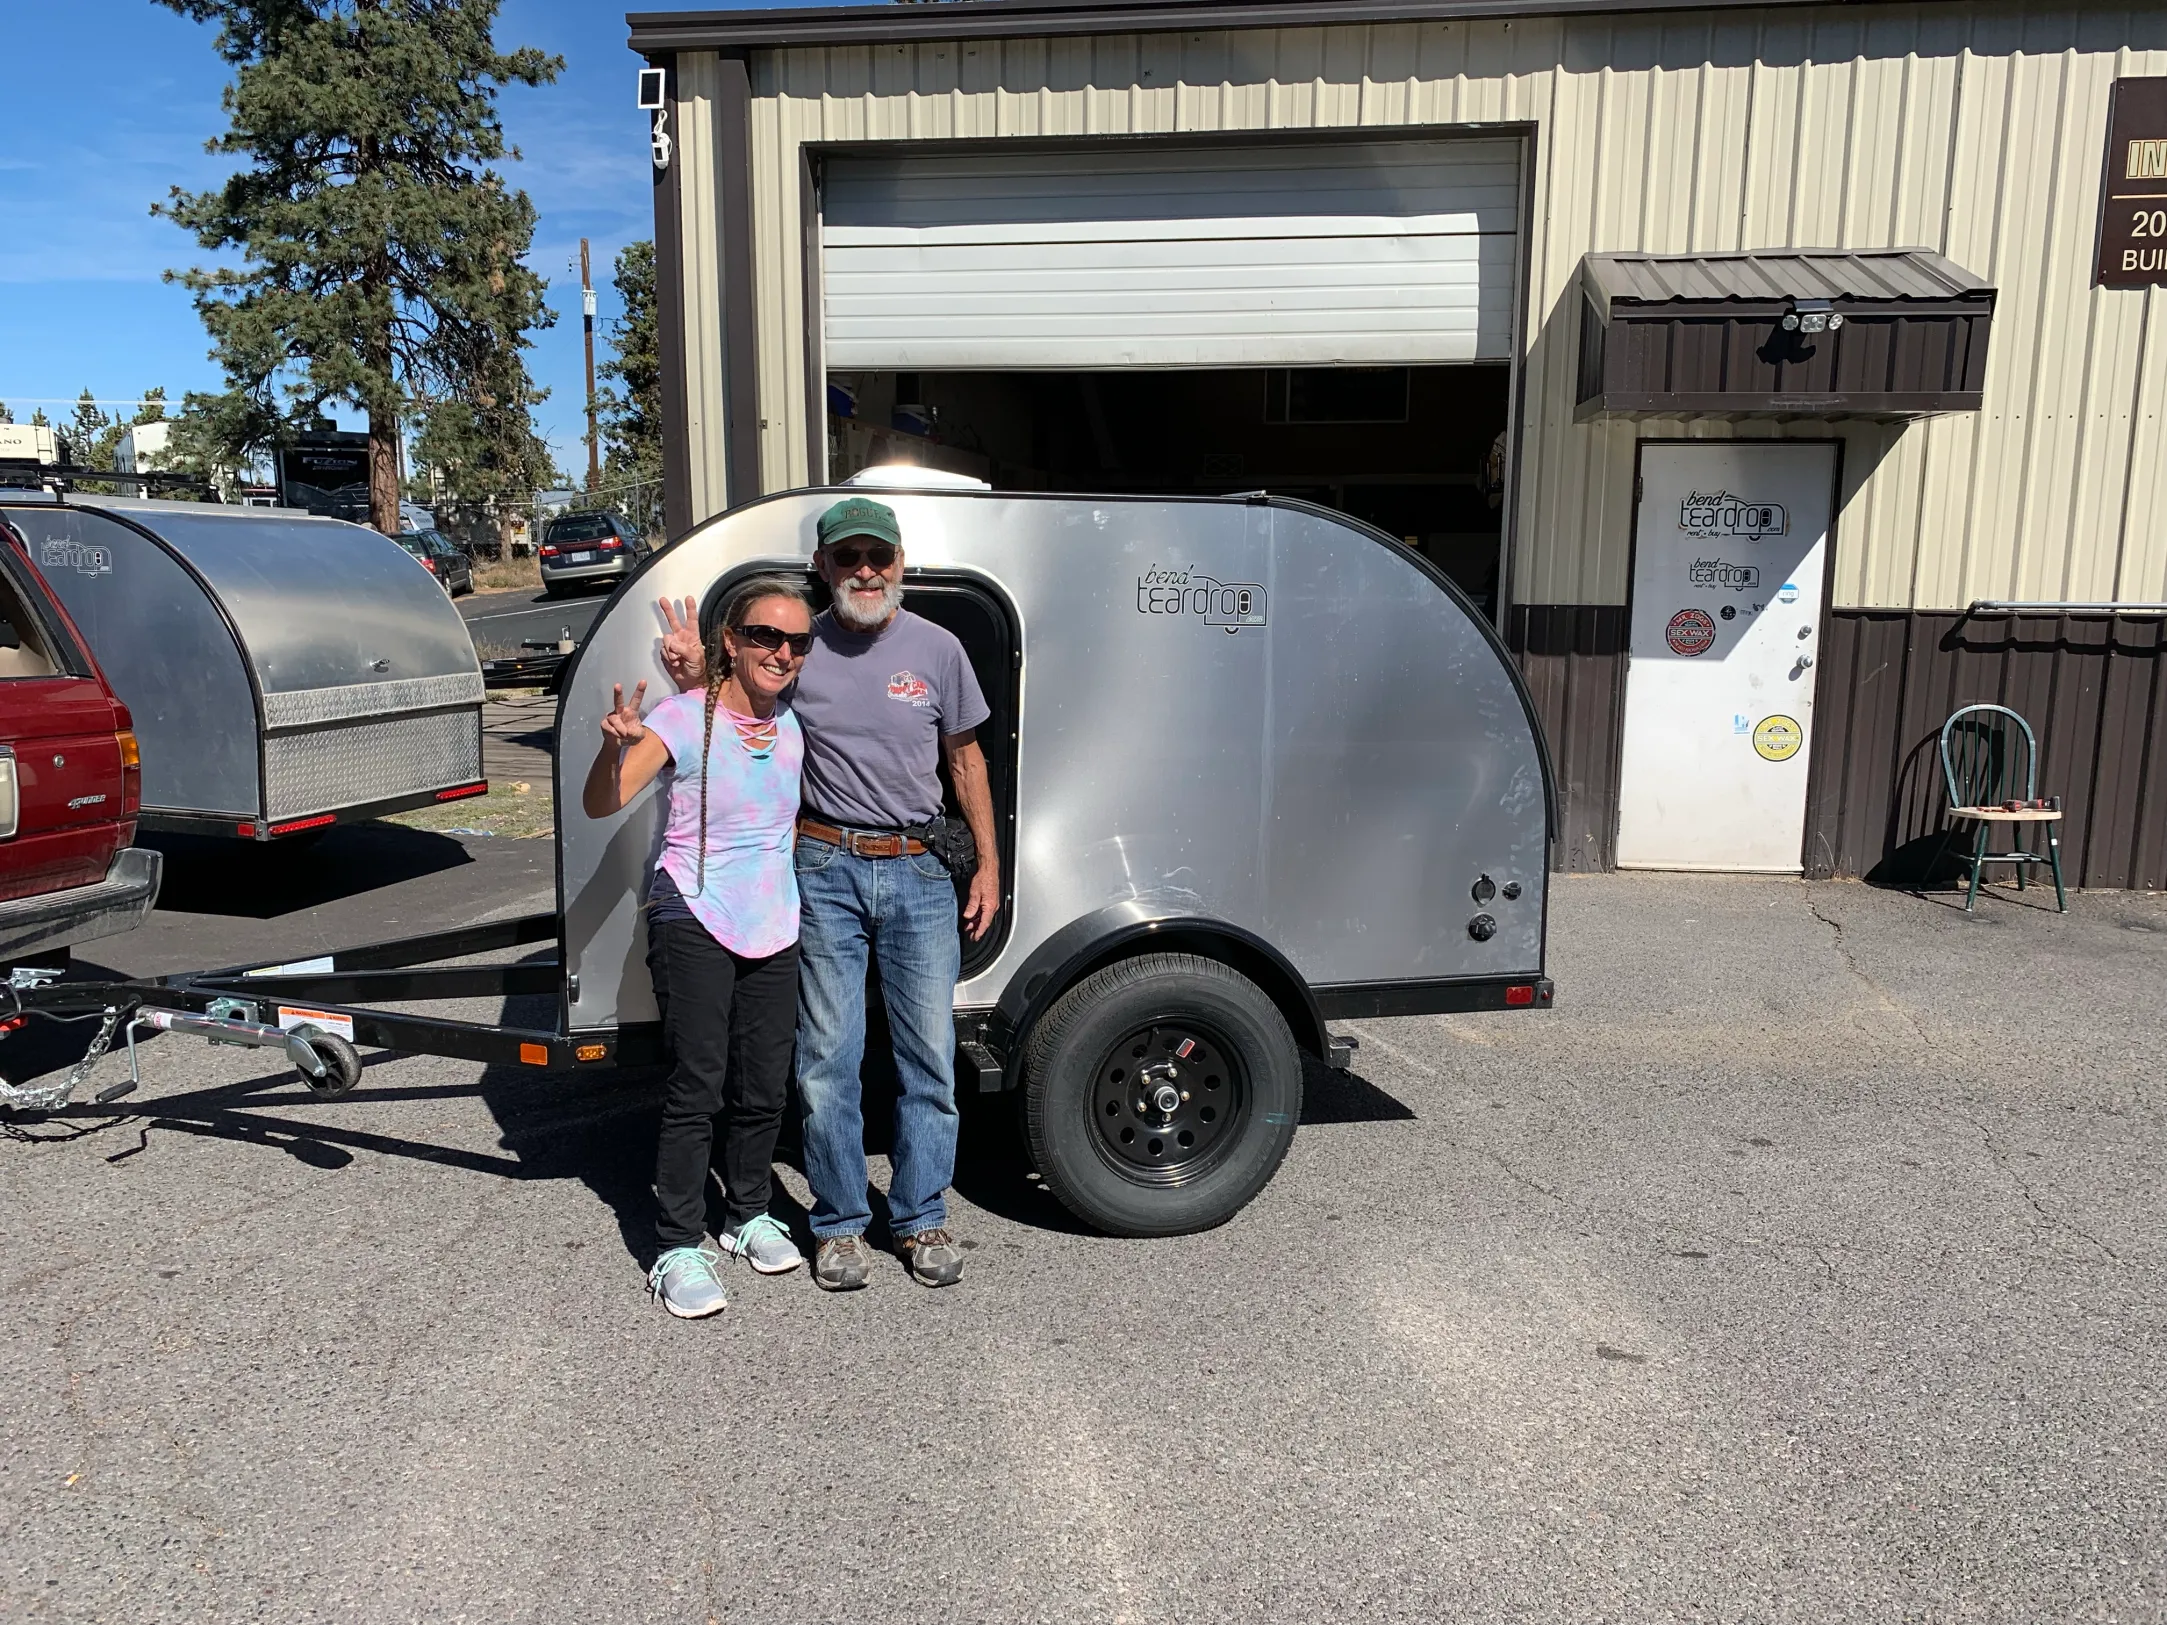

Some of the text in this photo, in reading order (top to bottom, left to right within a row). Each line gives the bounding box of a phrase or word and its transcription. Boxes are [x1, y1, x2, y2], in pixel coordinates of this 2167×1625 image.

[2121, 249, 2167, 271] BUI
[1686, 490, 1726, 506] bend
[1680, 499, 1772, 533] teardrop
[1144, 562, 1195, 585] bend
[1693, 557, 1721, 569] bend
[1689, 563, 1751, 586] teardrop
[1136, 576, 1252, 623] teardrop
[1690, 629, 1710, 637] WAX
